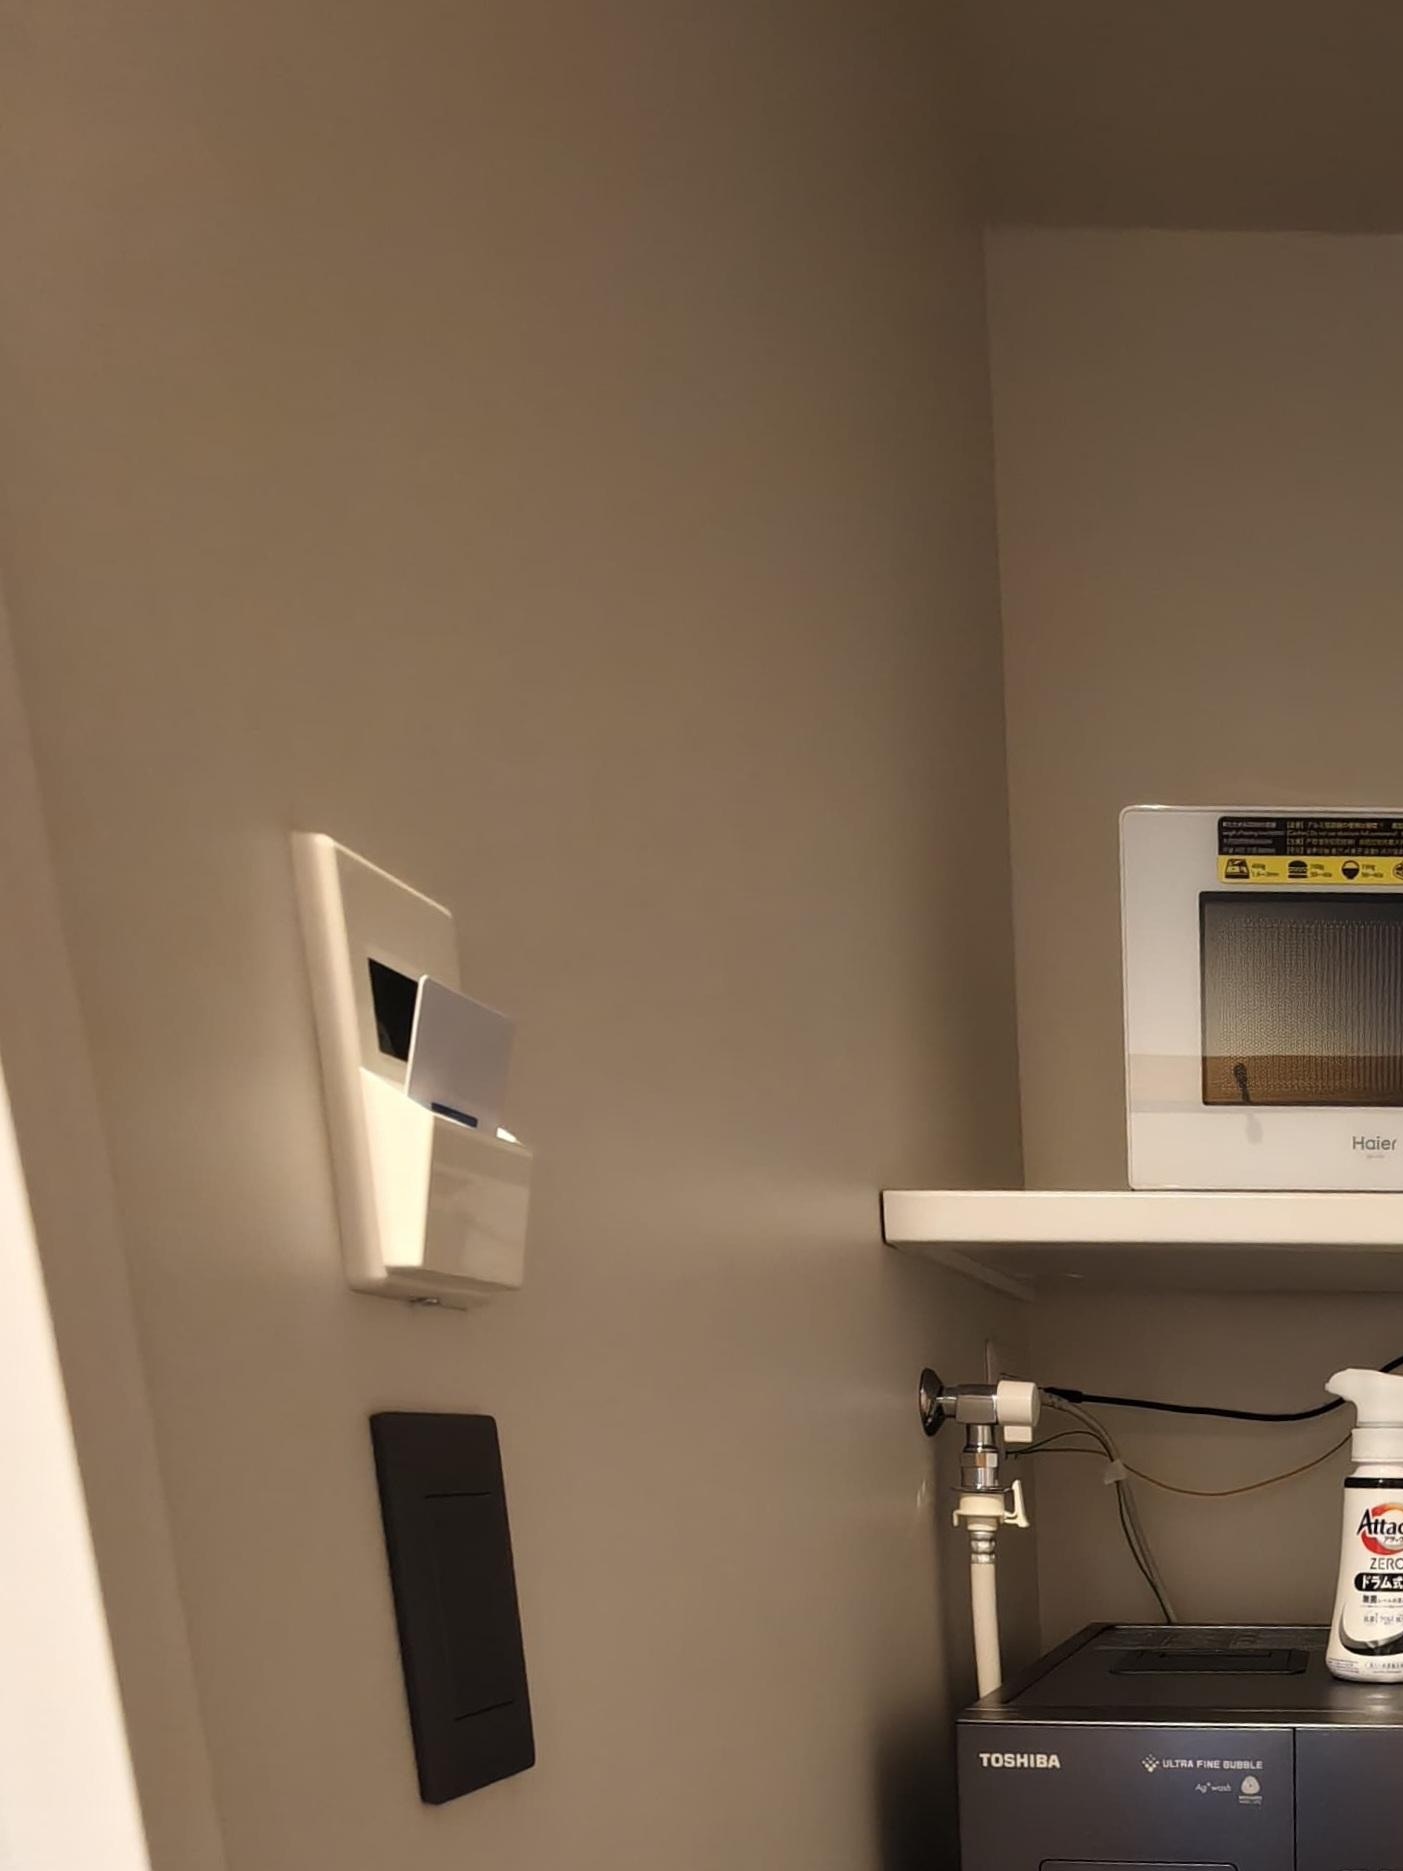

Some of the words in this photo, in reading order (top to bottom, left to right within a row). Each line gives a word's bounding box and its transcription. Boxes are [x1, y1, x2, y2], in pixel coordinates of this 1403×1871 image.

[1352, 1135, 1397, 1150] Haier
[979, 1752, 1061, 1769] TOSHIBA
[1162, 1759, 1194, 1769] ULTRA
[1196, 1759, 1220, 1769] FINE
[1222, 1760, 1264, 1770] BUBBLE
